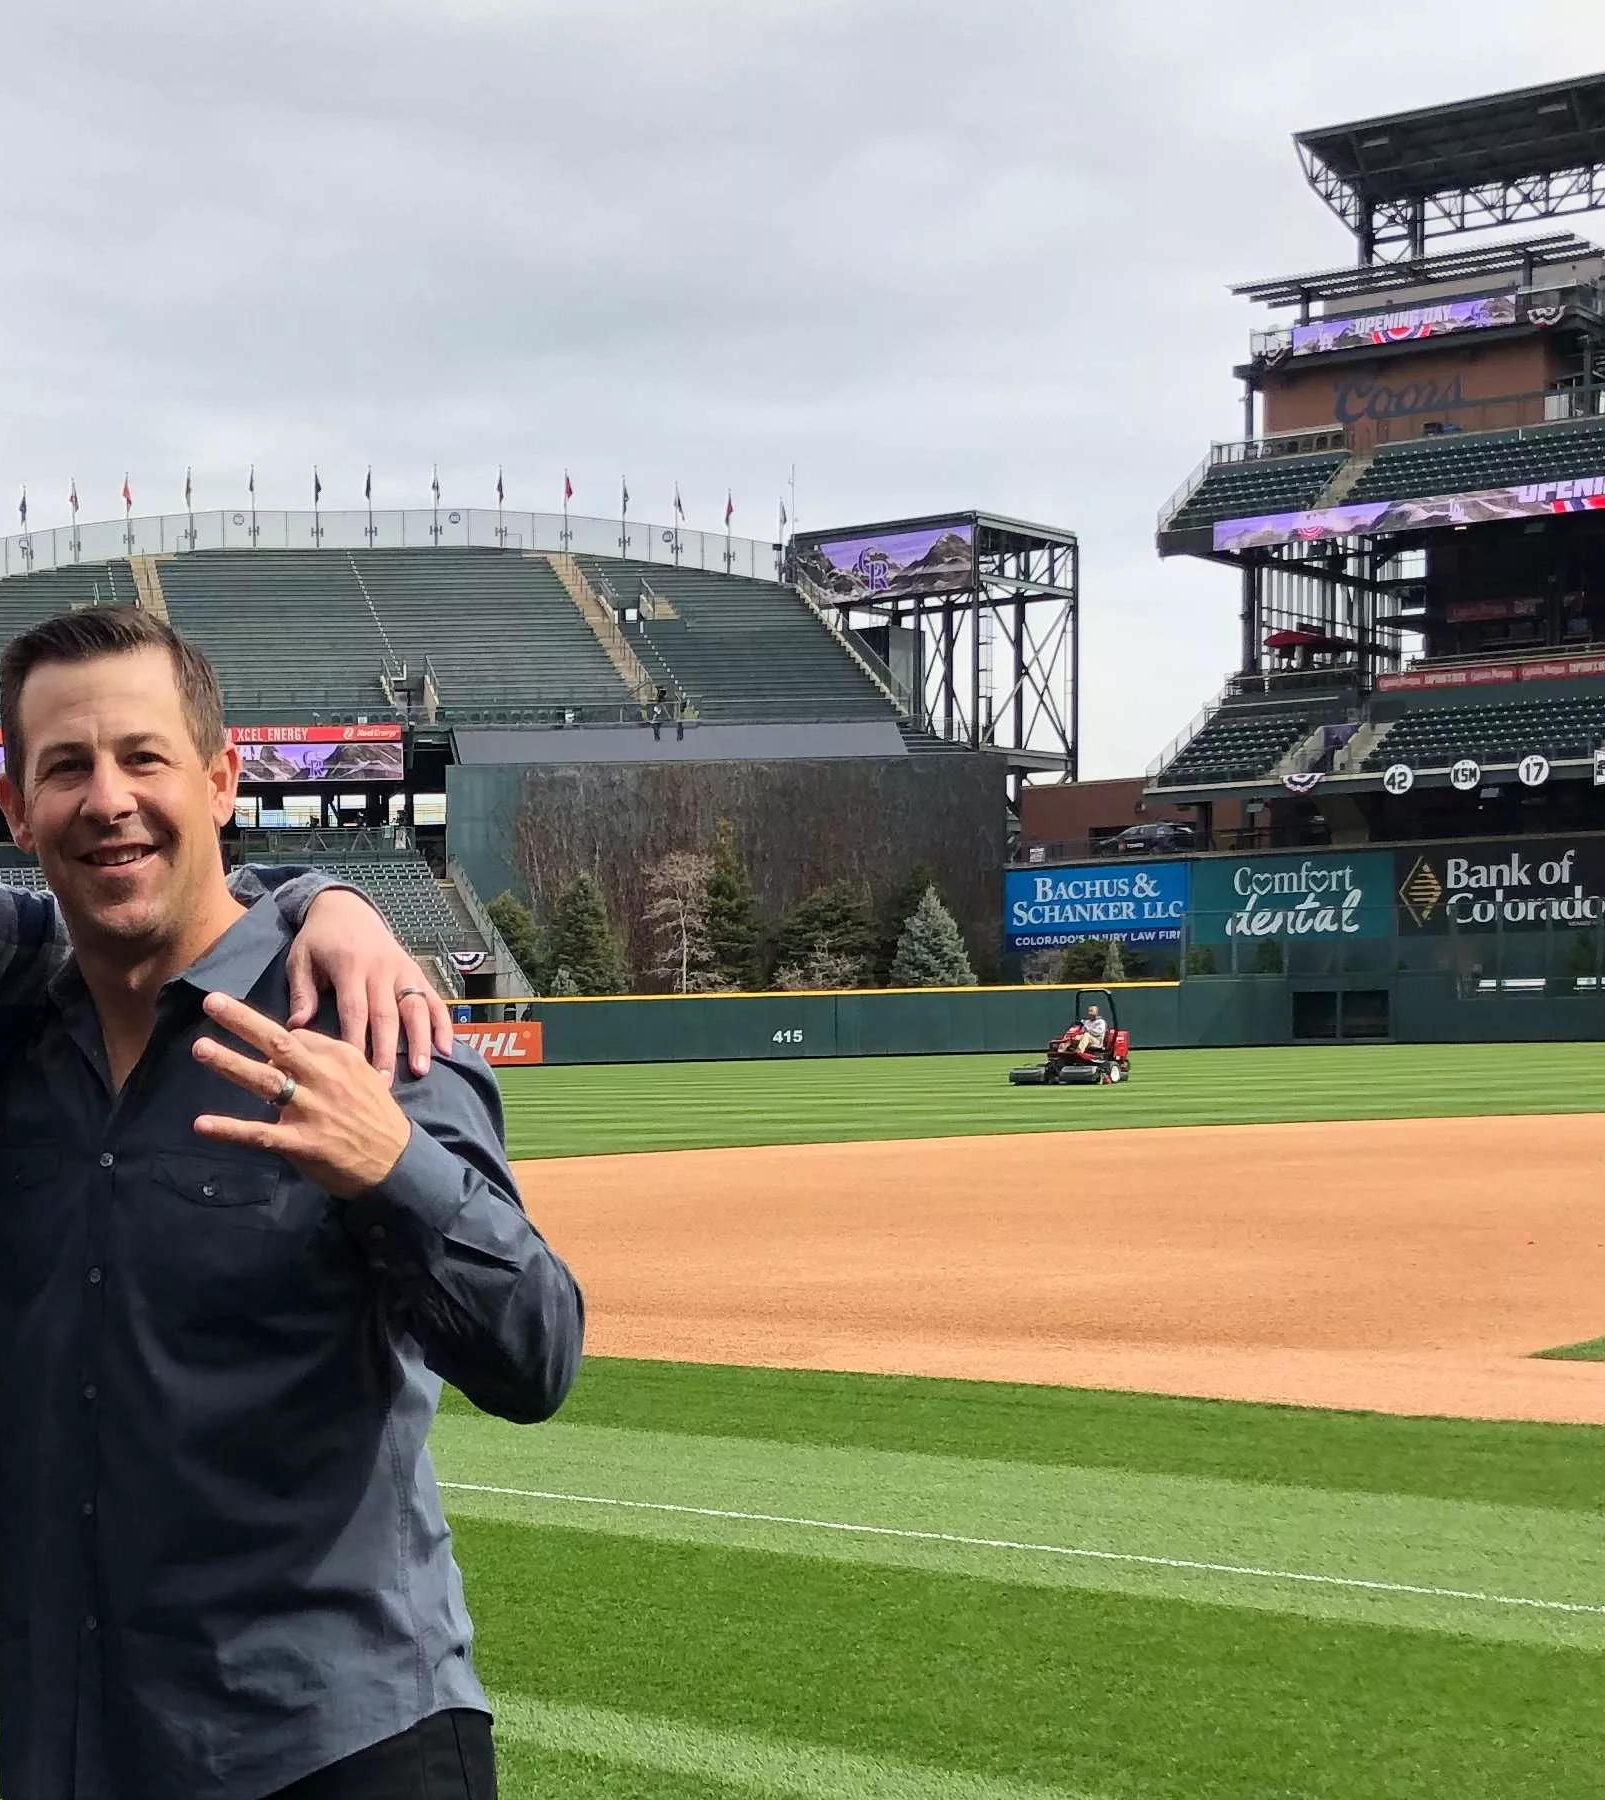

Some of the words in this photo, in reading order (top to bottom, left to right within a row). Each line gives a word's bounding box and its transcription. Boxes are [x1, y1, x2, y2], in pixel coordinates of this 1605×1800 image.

[236, 727, 263, 742] XCEL
[267, 727, 309, 741] ENERGY
[1386, 771, 1408, 791] 42
[1453, 767, 1478, 784] KSM
[1524, 761, 1545, 782] 17
[1233, 861, 1354, 896] Comfort
[1446, 852, 1532, 889] Bank
[1538, 849, 1575, 885] of
[1132, 872, 1161, 898] &
[1144, 901, 1184, 919] LLC
[1225, 888, 1362, 937] dental
[1015, 933, 1086, 947] COLORADO'S
[1130, 931, 1156, 942] LAW
[772, 1030, 803, 1044] 415
